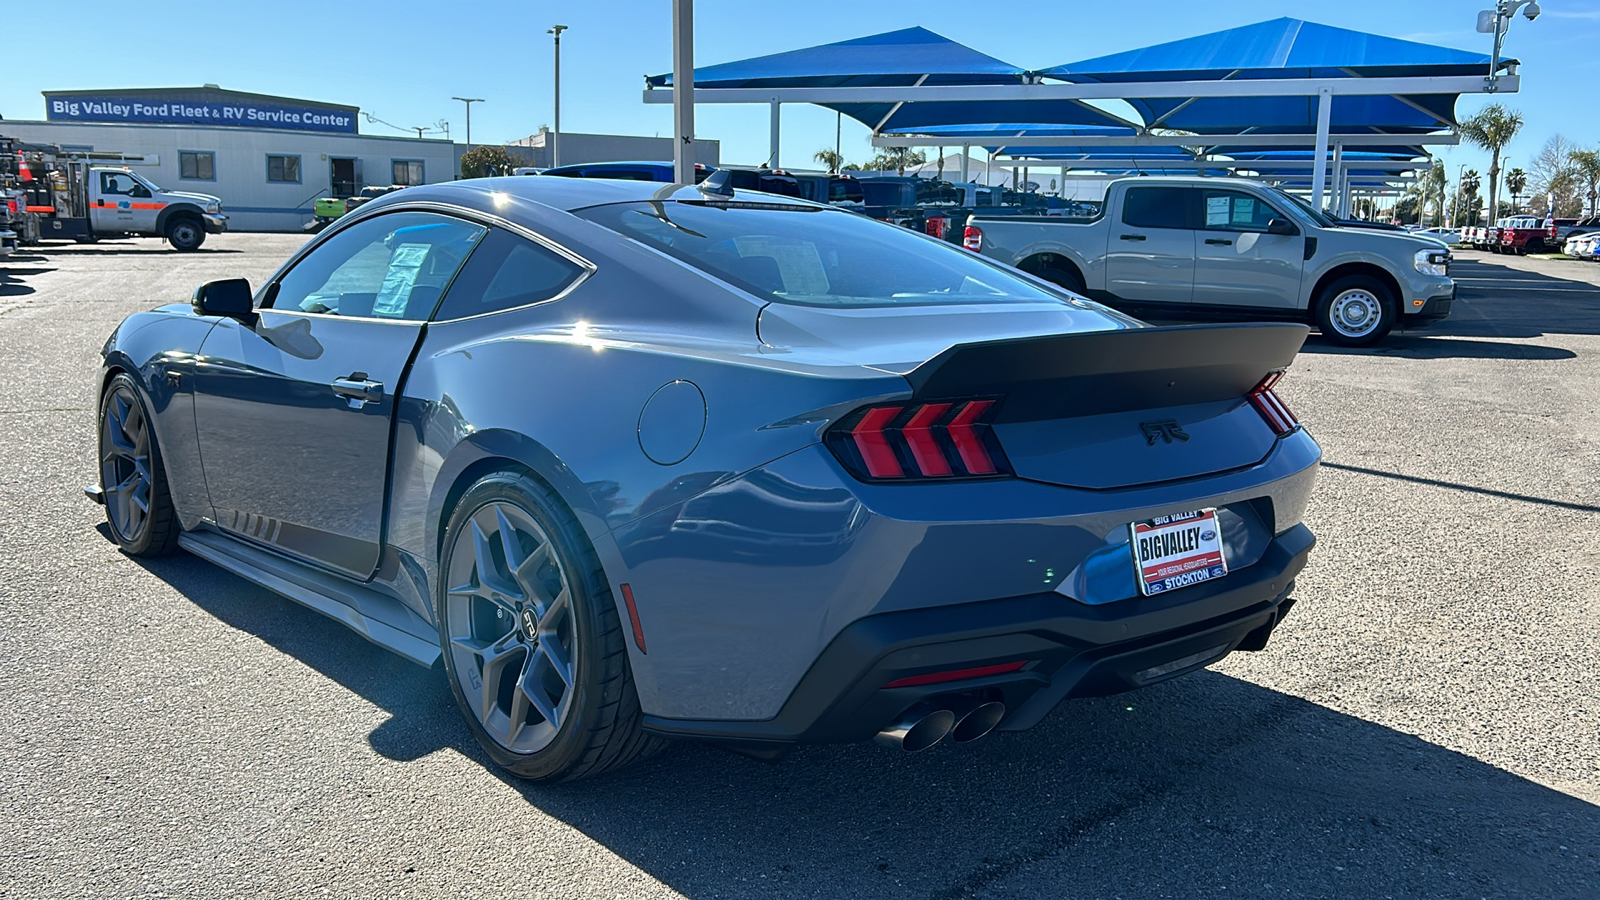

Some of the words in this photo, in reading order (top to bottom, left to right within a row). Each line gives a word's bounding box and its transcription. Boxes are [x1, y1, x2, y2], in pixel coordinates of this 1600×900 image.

[53, 101, 80, 116] Big
[82, 102, 130, 117] Valley
[133, 104, 168, 116] Ford
[171, 105, 209, 118] Fleet
[212, 109, 220, 118] &
[223, 107, 244, 119] RV
[247, 108, 300, 123] Service
[302, 112, 350, 126] Center
[1154, 515, 1170, 526] BIG
[1170, 510, 1198, 522] VALLEY
[1140, 526, 1200, 561] BIGVALLEY
[1165, 568, 1210, 589] STOCKTON
